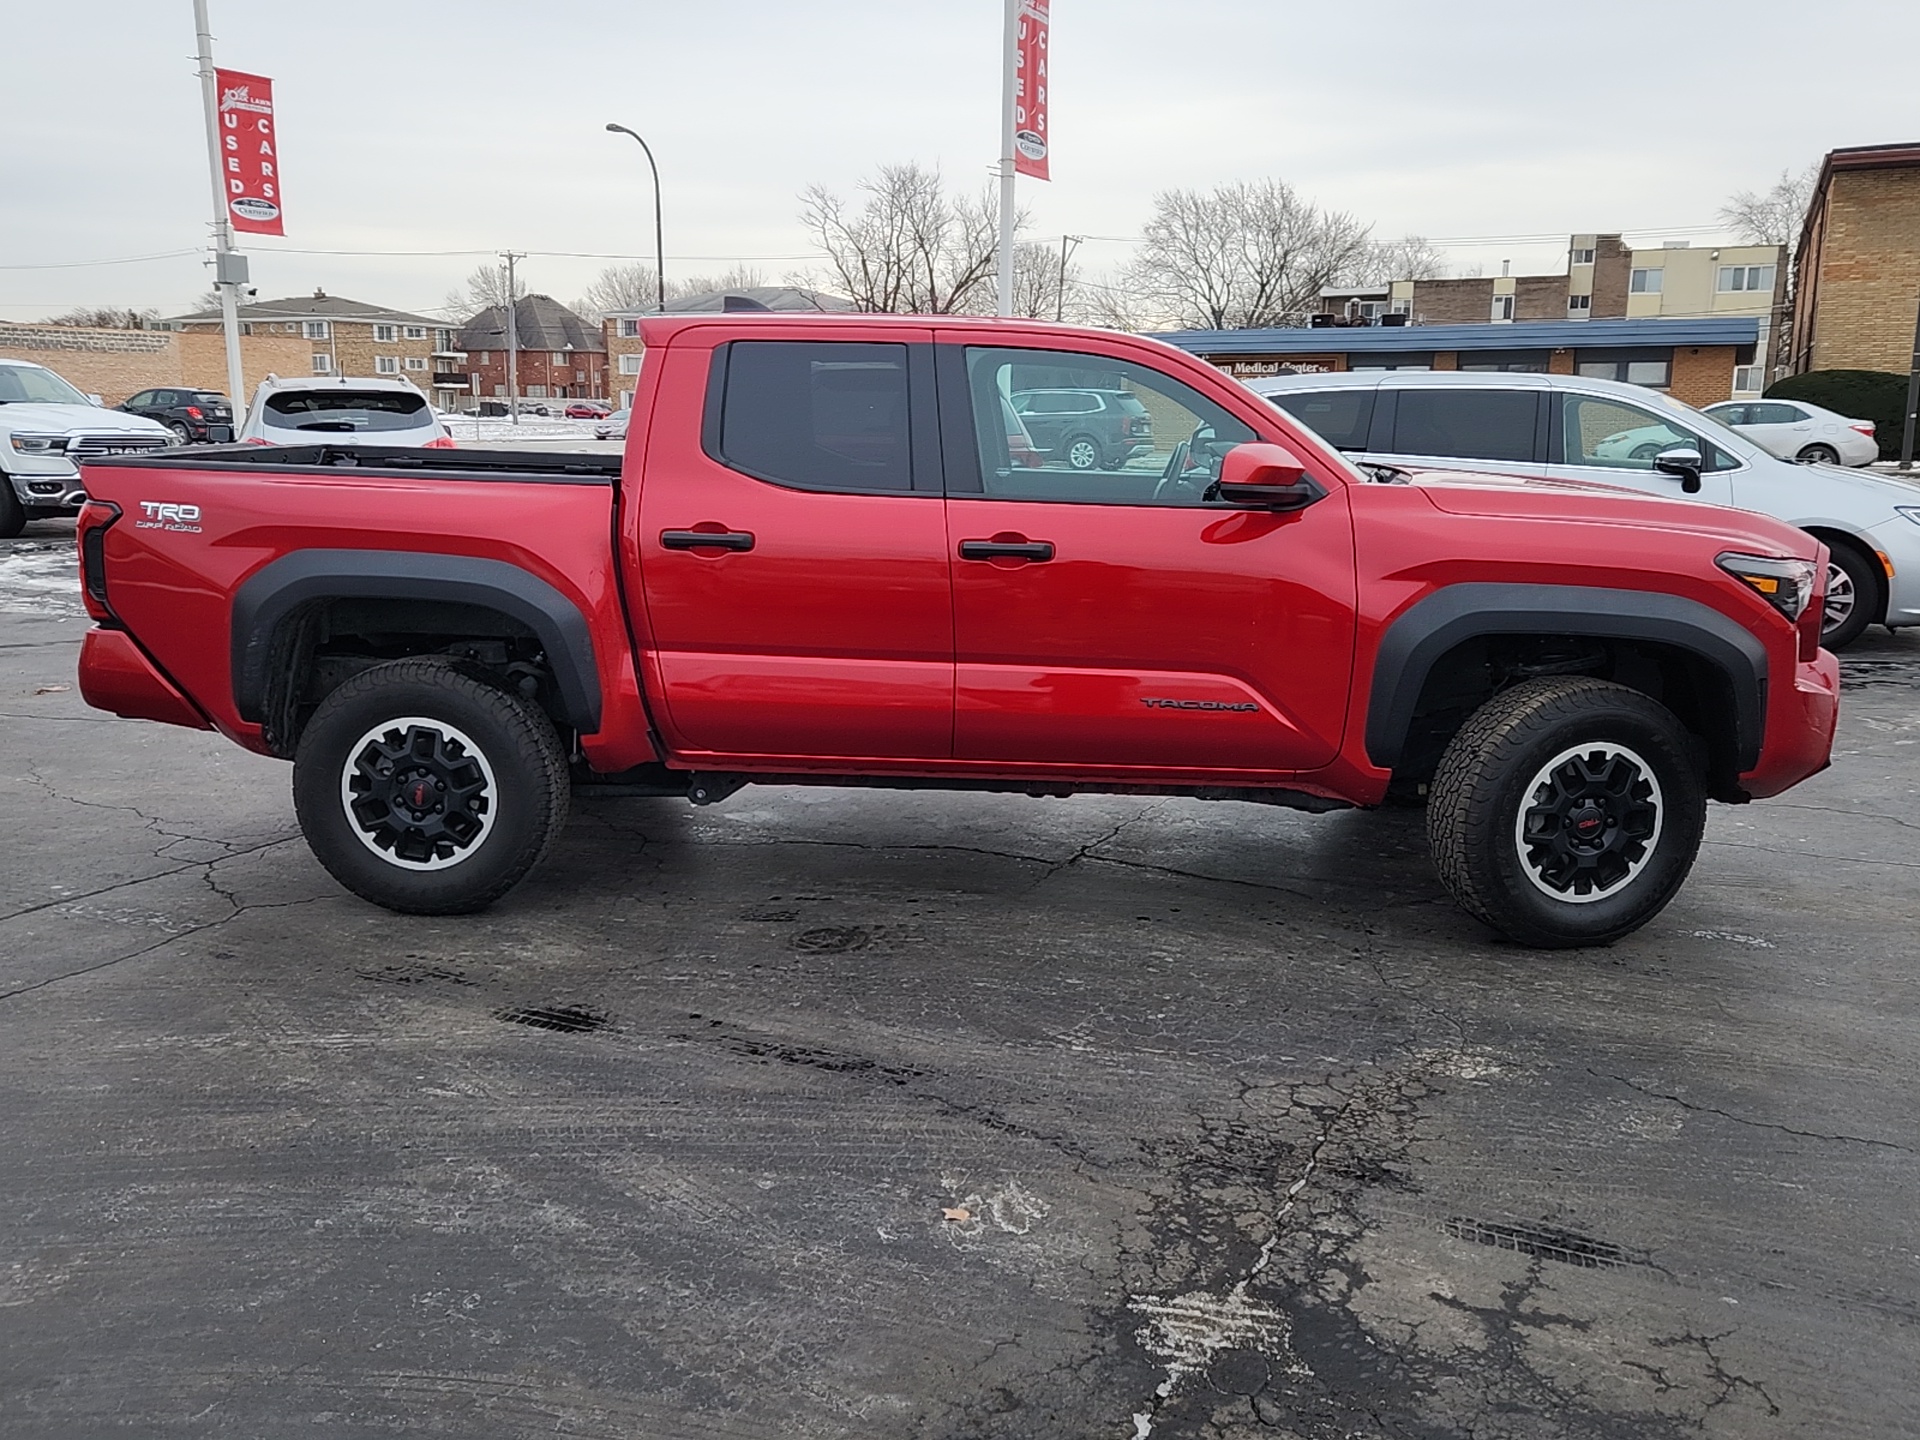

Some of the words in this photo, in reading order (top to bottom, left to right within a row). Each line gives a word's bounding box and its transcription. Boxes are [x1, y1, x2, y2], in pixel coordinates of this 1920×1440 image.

[1016, 22, 1027, 123] USED
[1038, 30, 1047, 131] CARS
[223, 113, 245, 194] USED
[257, 118, 275, 198] CARS
[1234, 362, 1279, 374] Medical
[140, 501, 201, 522] TRD
[1140, 697, 1259, 712] TACOMA
